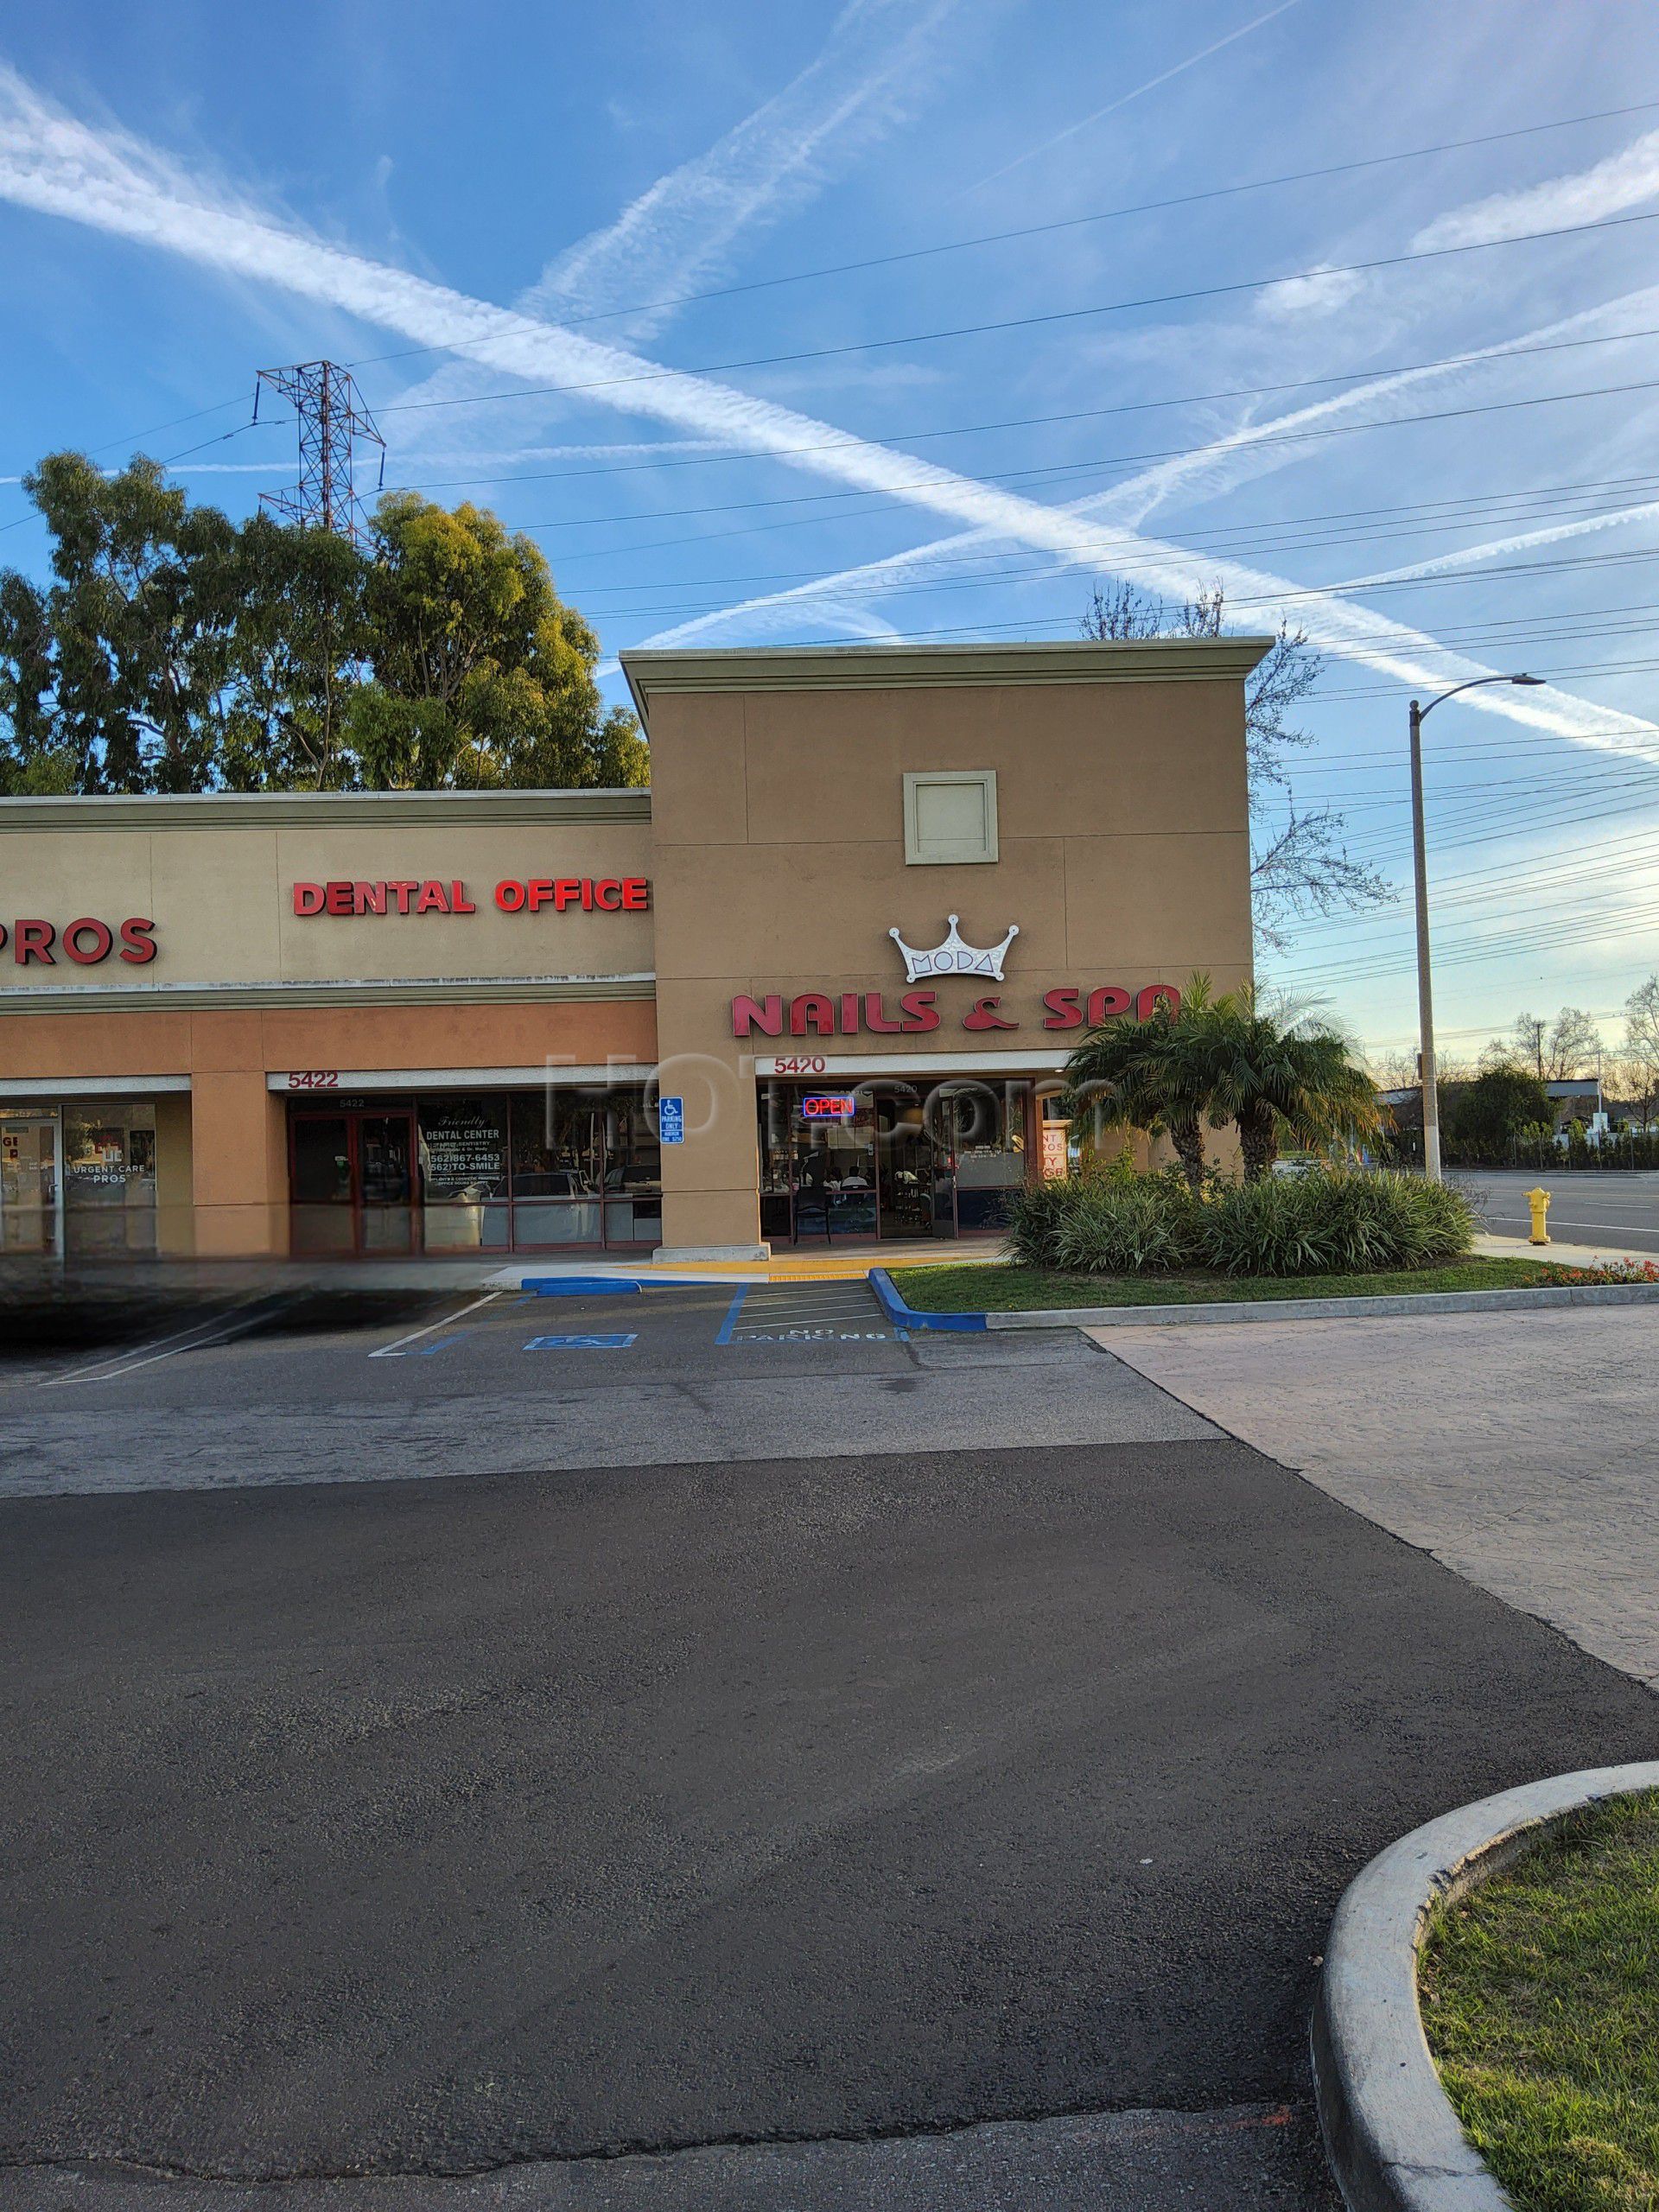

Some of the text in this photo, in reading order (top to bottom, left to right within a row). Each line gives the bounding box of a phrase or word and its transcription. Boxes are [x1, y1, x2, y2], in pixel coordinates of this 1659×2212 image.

[292, 877, 649, 916] DENTAL OFFICE
[0, 917, 158, 965] ROS
[911, 950, 995, 975] MODA
[732, 983, 1181, 1037] NAILS & SPA
[774, 1056, 826, 1074] 5420
[288, 1070, 340, 1089] 5422
[894, 1084, 918, 1094] 5420
[340, 1098, 365, 1108] 5422
[804, 1097, 854, 1115] OPEN
[438, 1116, 485, 1128] Friendly
[426, 1129, 500, 1141] DENTAL CENTER
[73, 1165, 146, 1174] URGENT CARE
[92, 1174, 128, 1184] PROS
